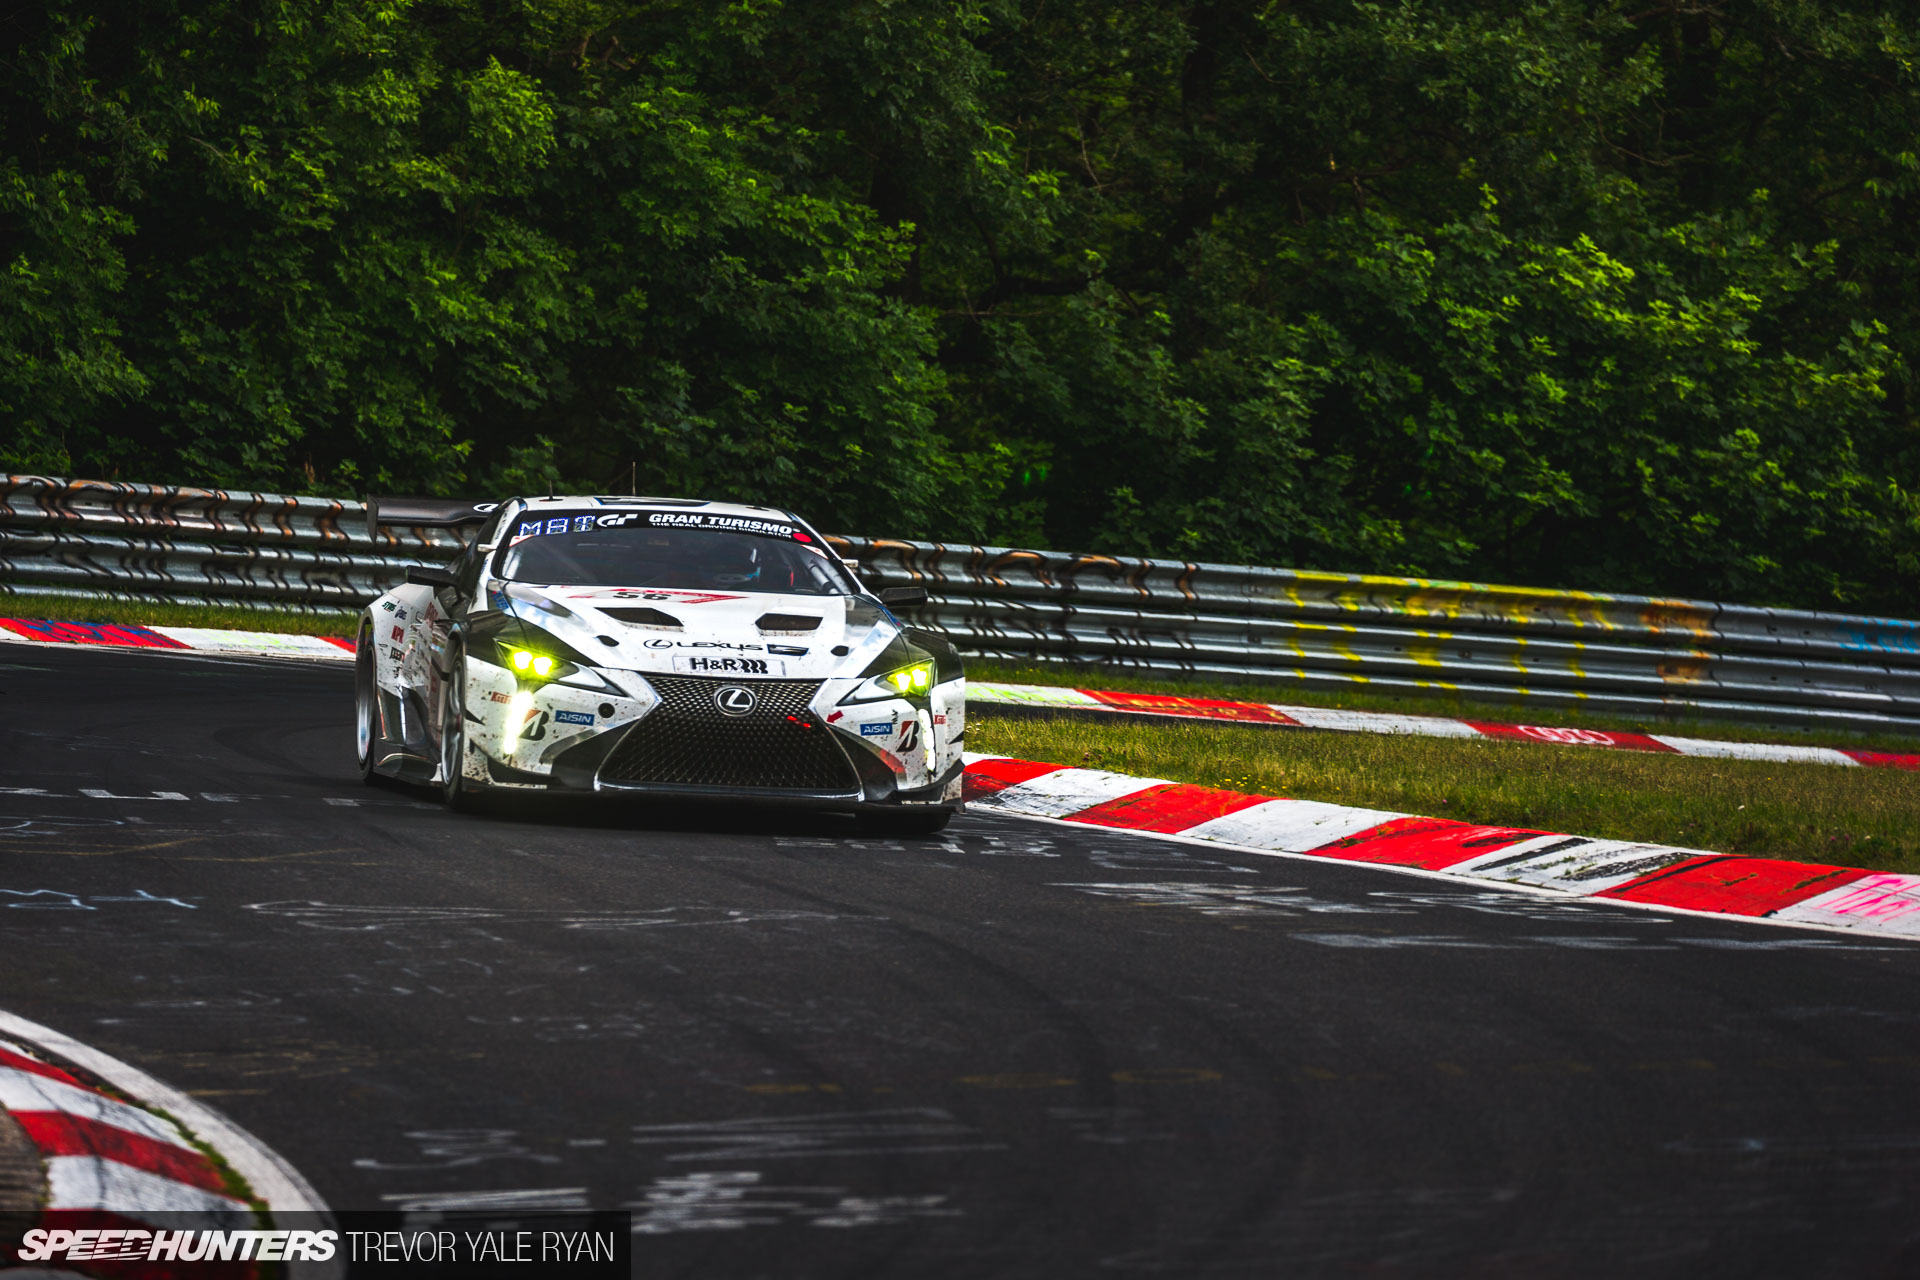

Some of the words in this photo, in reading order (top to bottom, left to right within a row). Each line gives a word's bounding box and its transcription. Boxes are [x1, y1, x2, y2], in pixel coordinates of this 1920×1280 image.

[649, 513, 703, 524] GRAN
[707, 516, 794, 535] TURISMO
[676, 641, 763, 651] LEXUS
[689, 657, 739, 671] H&R
[559, 713, 592, 723] AISIN
[864, 725, 890, 733] AISIN
